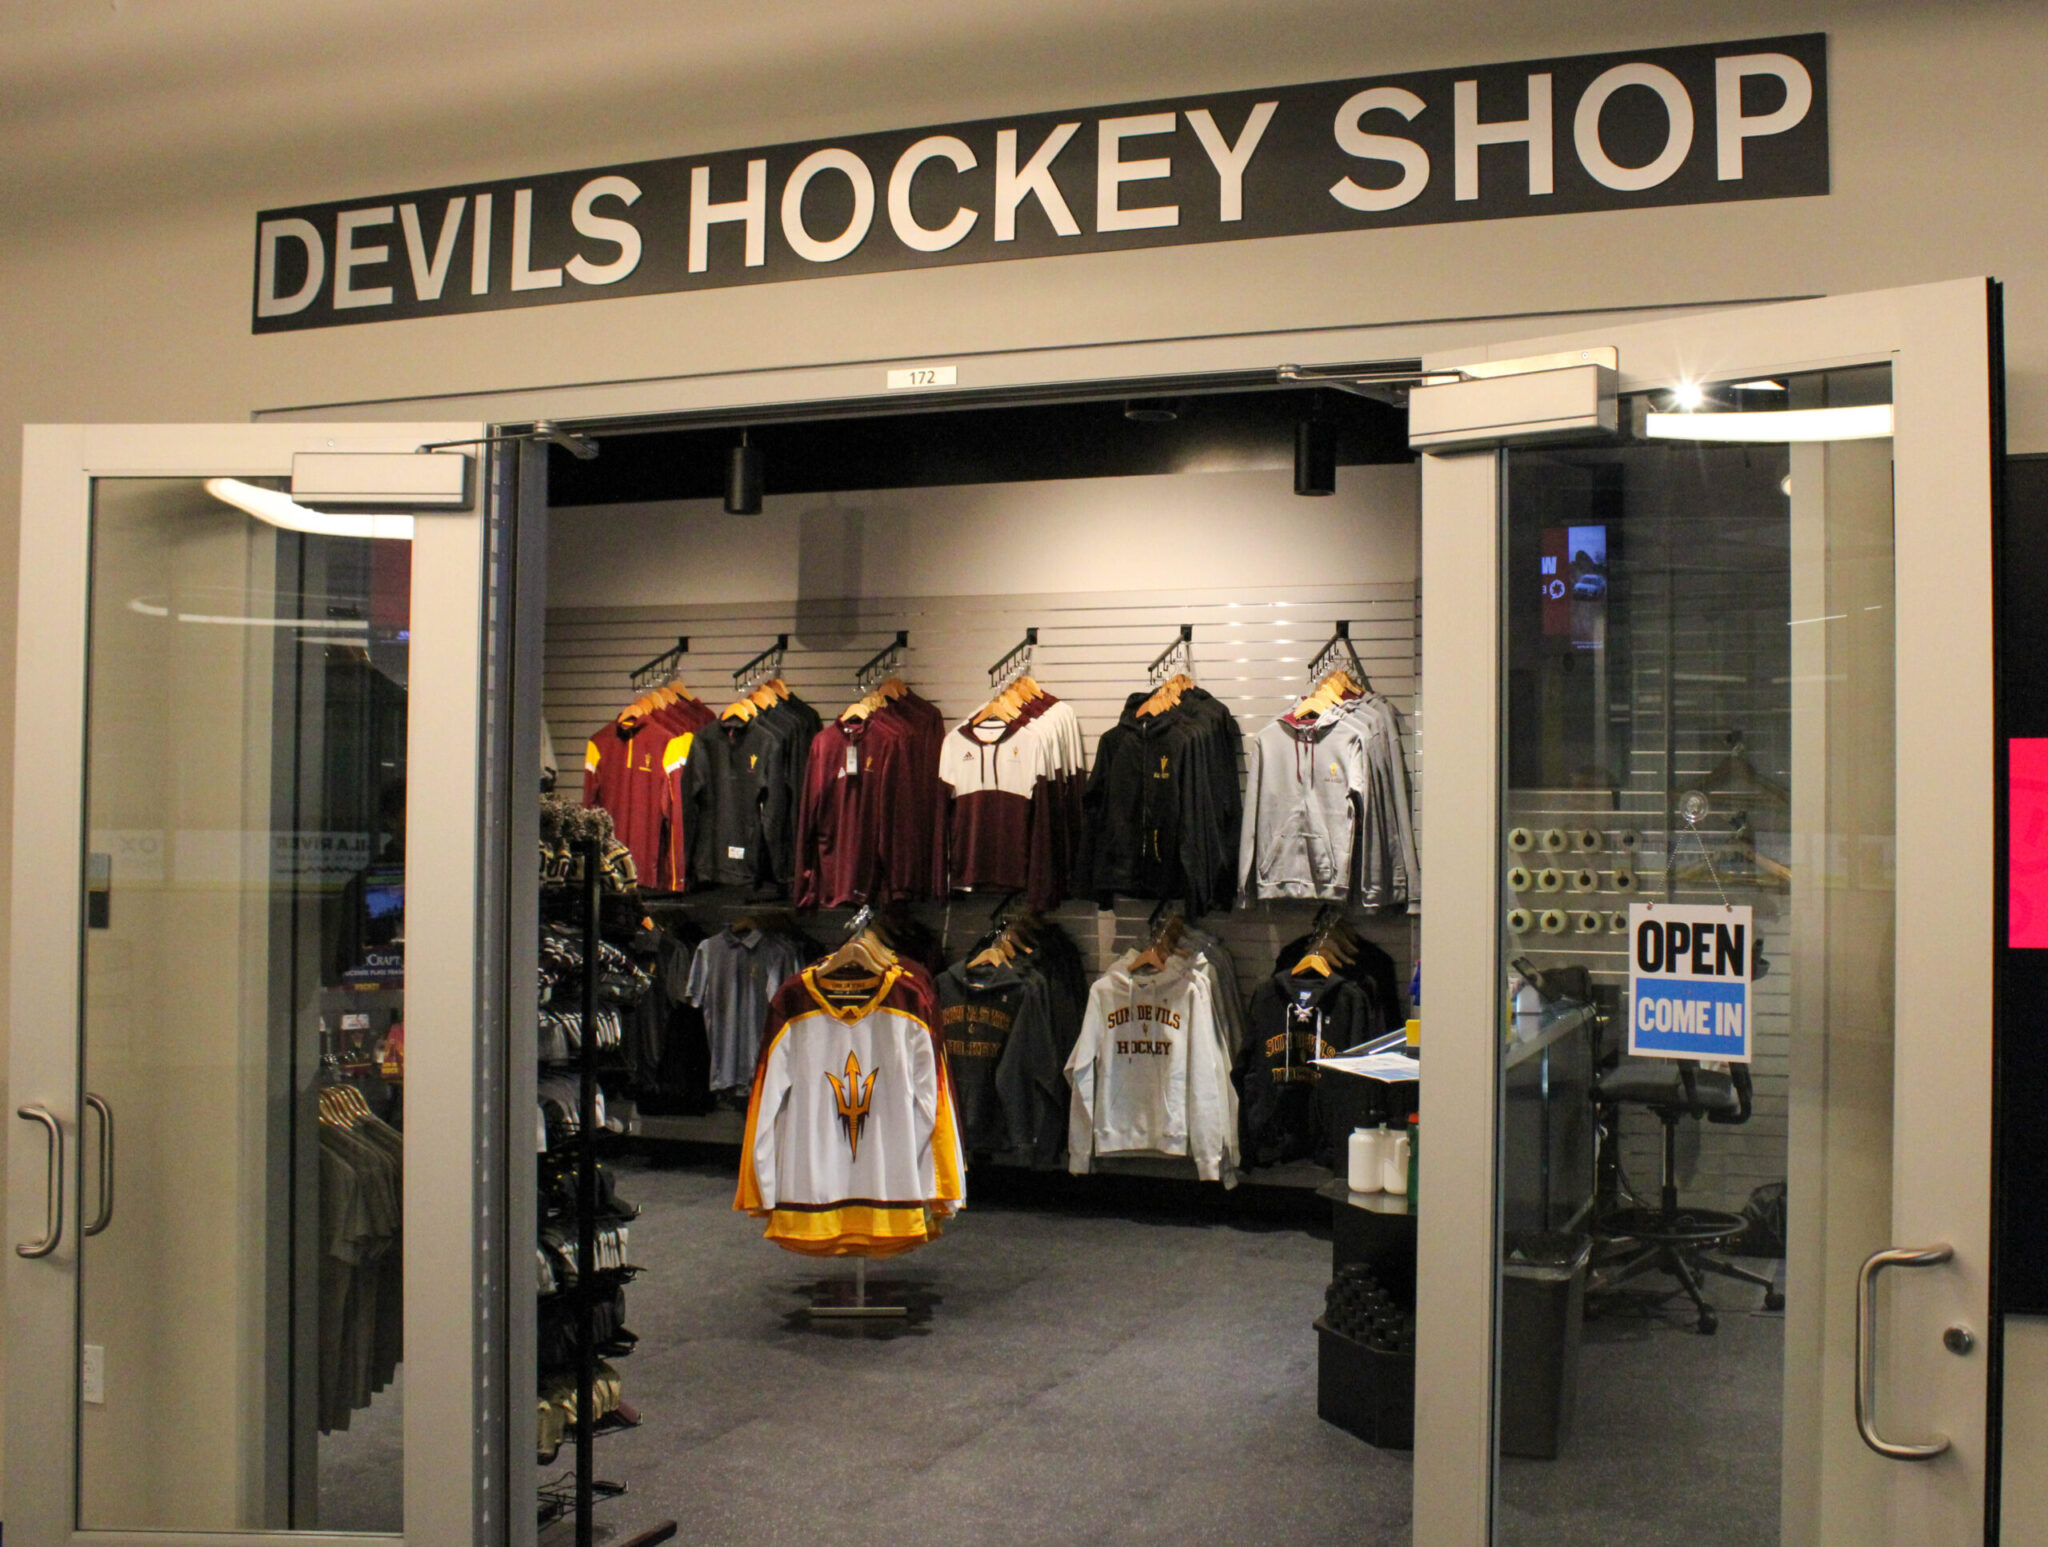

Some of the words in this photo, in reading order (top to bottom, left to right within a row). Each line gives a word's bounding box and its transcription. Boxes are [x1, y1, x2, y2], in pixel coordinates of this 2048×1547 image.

[257, 175, 643, 319] DEVILS
[687, 100, 1280, 274] HOCKEY
[1328, 52, 1813, 212] SHOP
[910, 370, 936, 385] 172
[1636, 919, 1745, 977] OPEN
[1107, 1006, 1133, 1029] SUN
[1136, 1004, 1181, 1031] DEVILS
[1637, 996, 1712, 1036] COME
[1715, 1001, 1743, 1037] IN
[1116, 1040, 1173, 1056] HOCKEY
